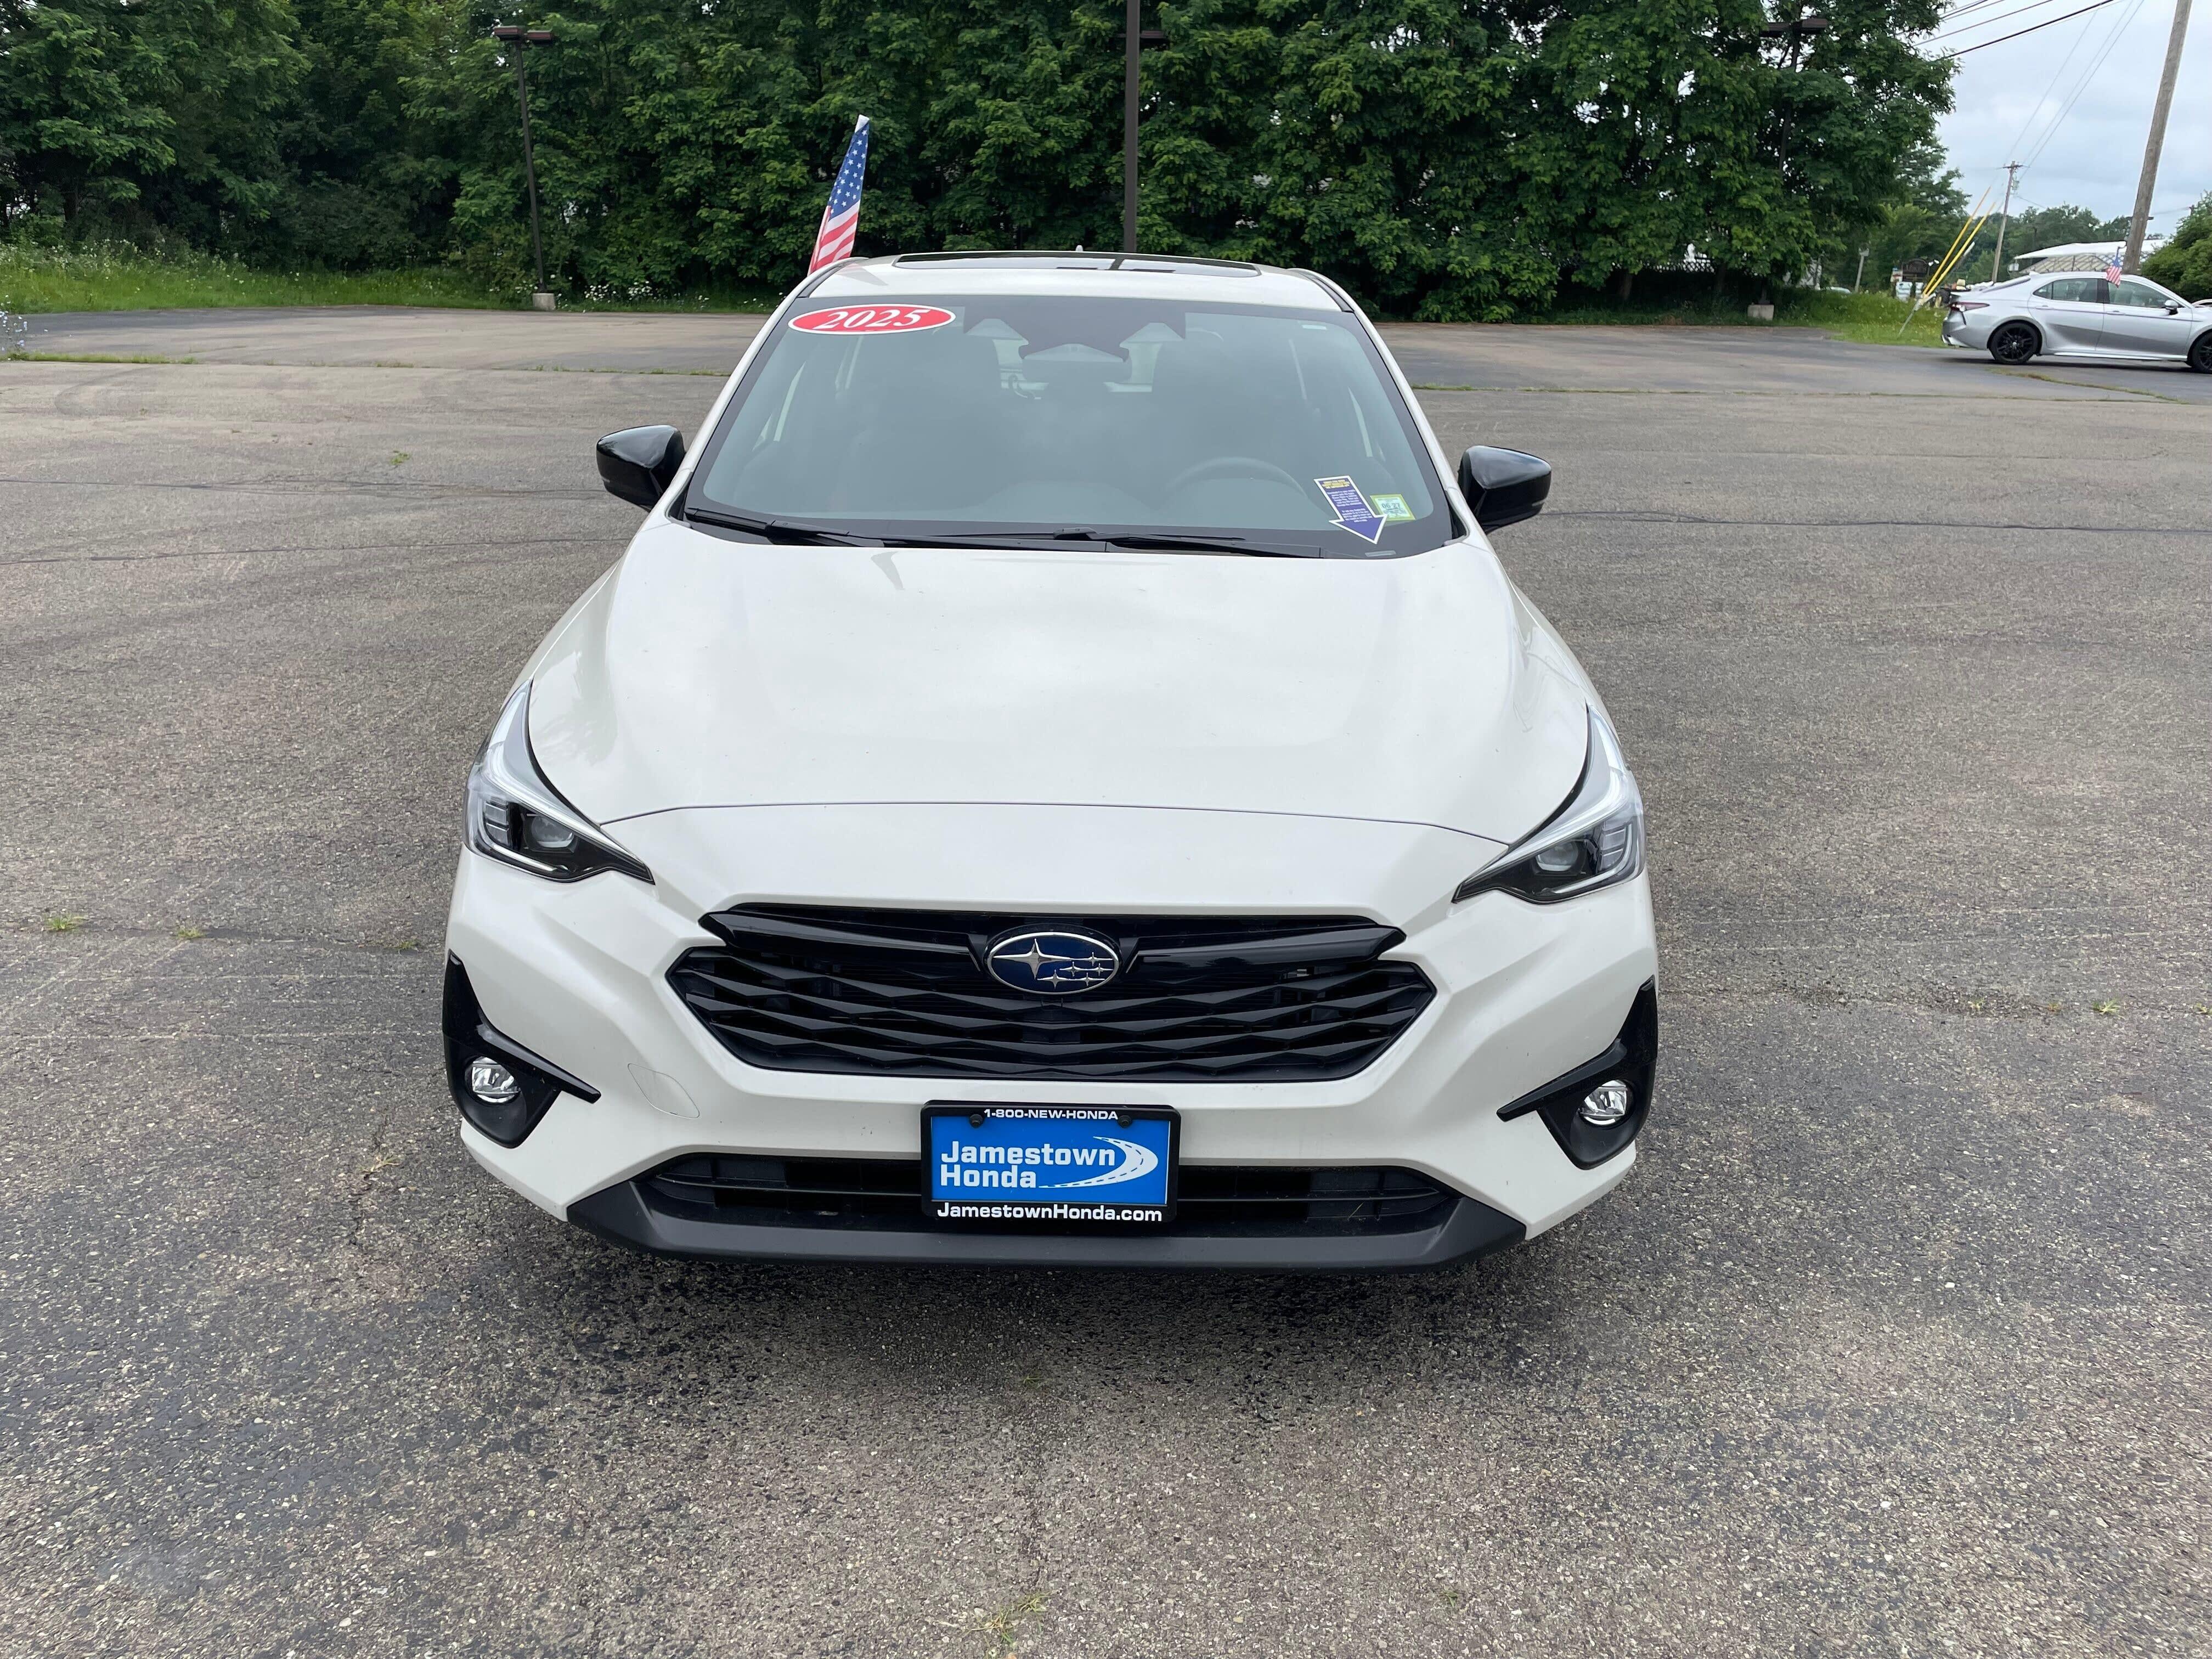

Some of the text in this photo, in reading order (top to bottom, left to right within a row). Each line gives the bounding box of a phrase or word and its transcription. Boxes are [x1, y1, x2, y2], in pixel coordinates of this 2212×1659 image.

[812, 309, 931, 329] 2025
[984, 1109, 1119, 1120] 1-800-NEW-HONDA
[941, 1141, 1115, 1166] Jamestown
[940, 1164, 1036, 1188] Honda
[937, 1202, 1163, 1222] JamestownHonda.com
